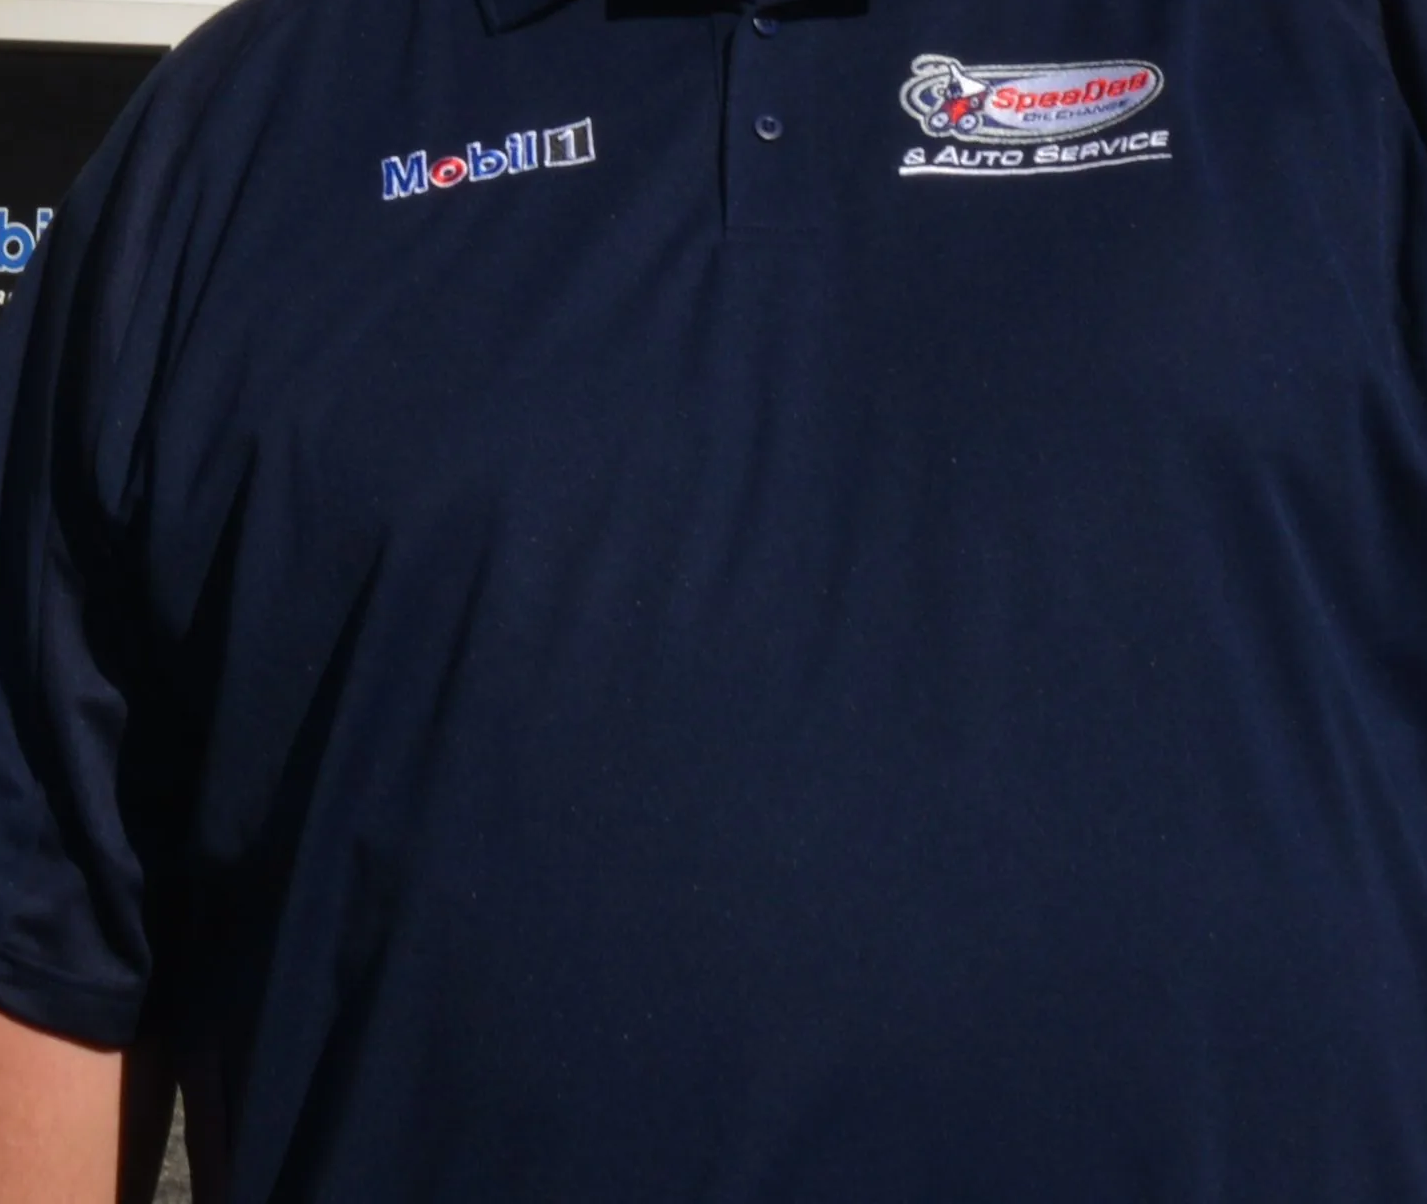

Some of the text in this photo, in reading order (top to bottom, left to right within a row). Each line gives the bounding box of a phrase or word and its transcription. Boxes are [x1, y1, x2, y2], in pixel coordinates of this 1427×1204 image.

[381, 130, 539, 200] Mobil
[903, 130, 1170, 166] & AUTO SERVICE
